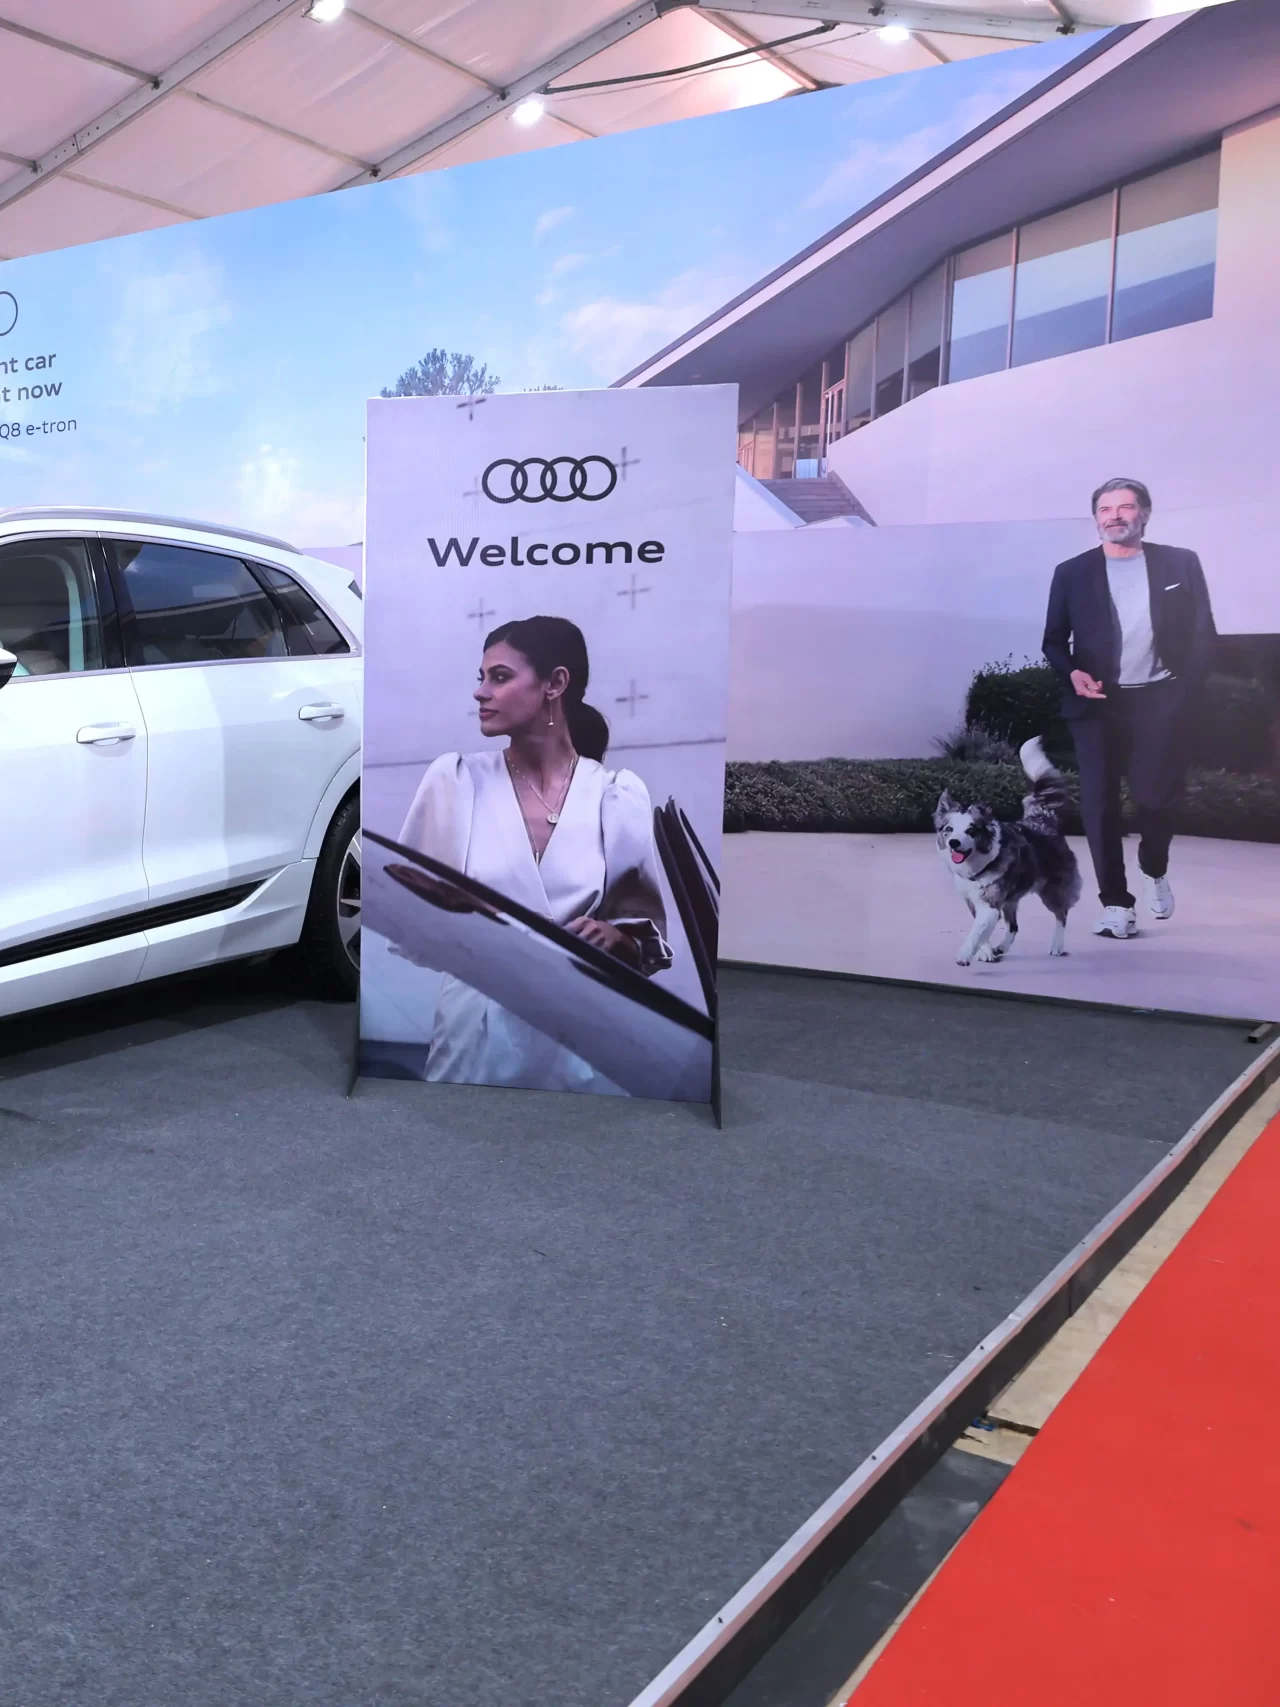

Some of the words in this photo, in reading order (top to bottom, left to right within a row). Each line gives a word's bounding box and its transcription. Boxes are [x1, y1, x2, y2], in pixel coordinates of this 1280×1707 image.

[25, 353, 57, 371] car
[17, 382, 62, 401] now
[0, 422, 21, 439] Q8
[26, 419, 77, 436] e-tron
[427, 536, 665, 567] Welcome
